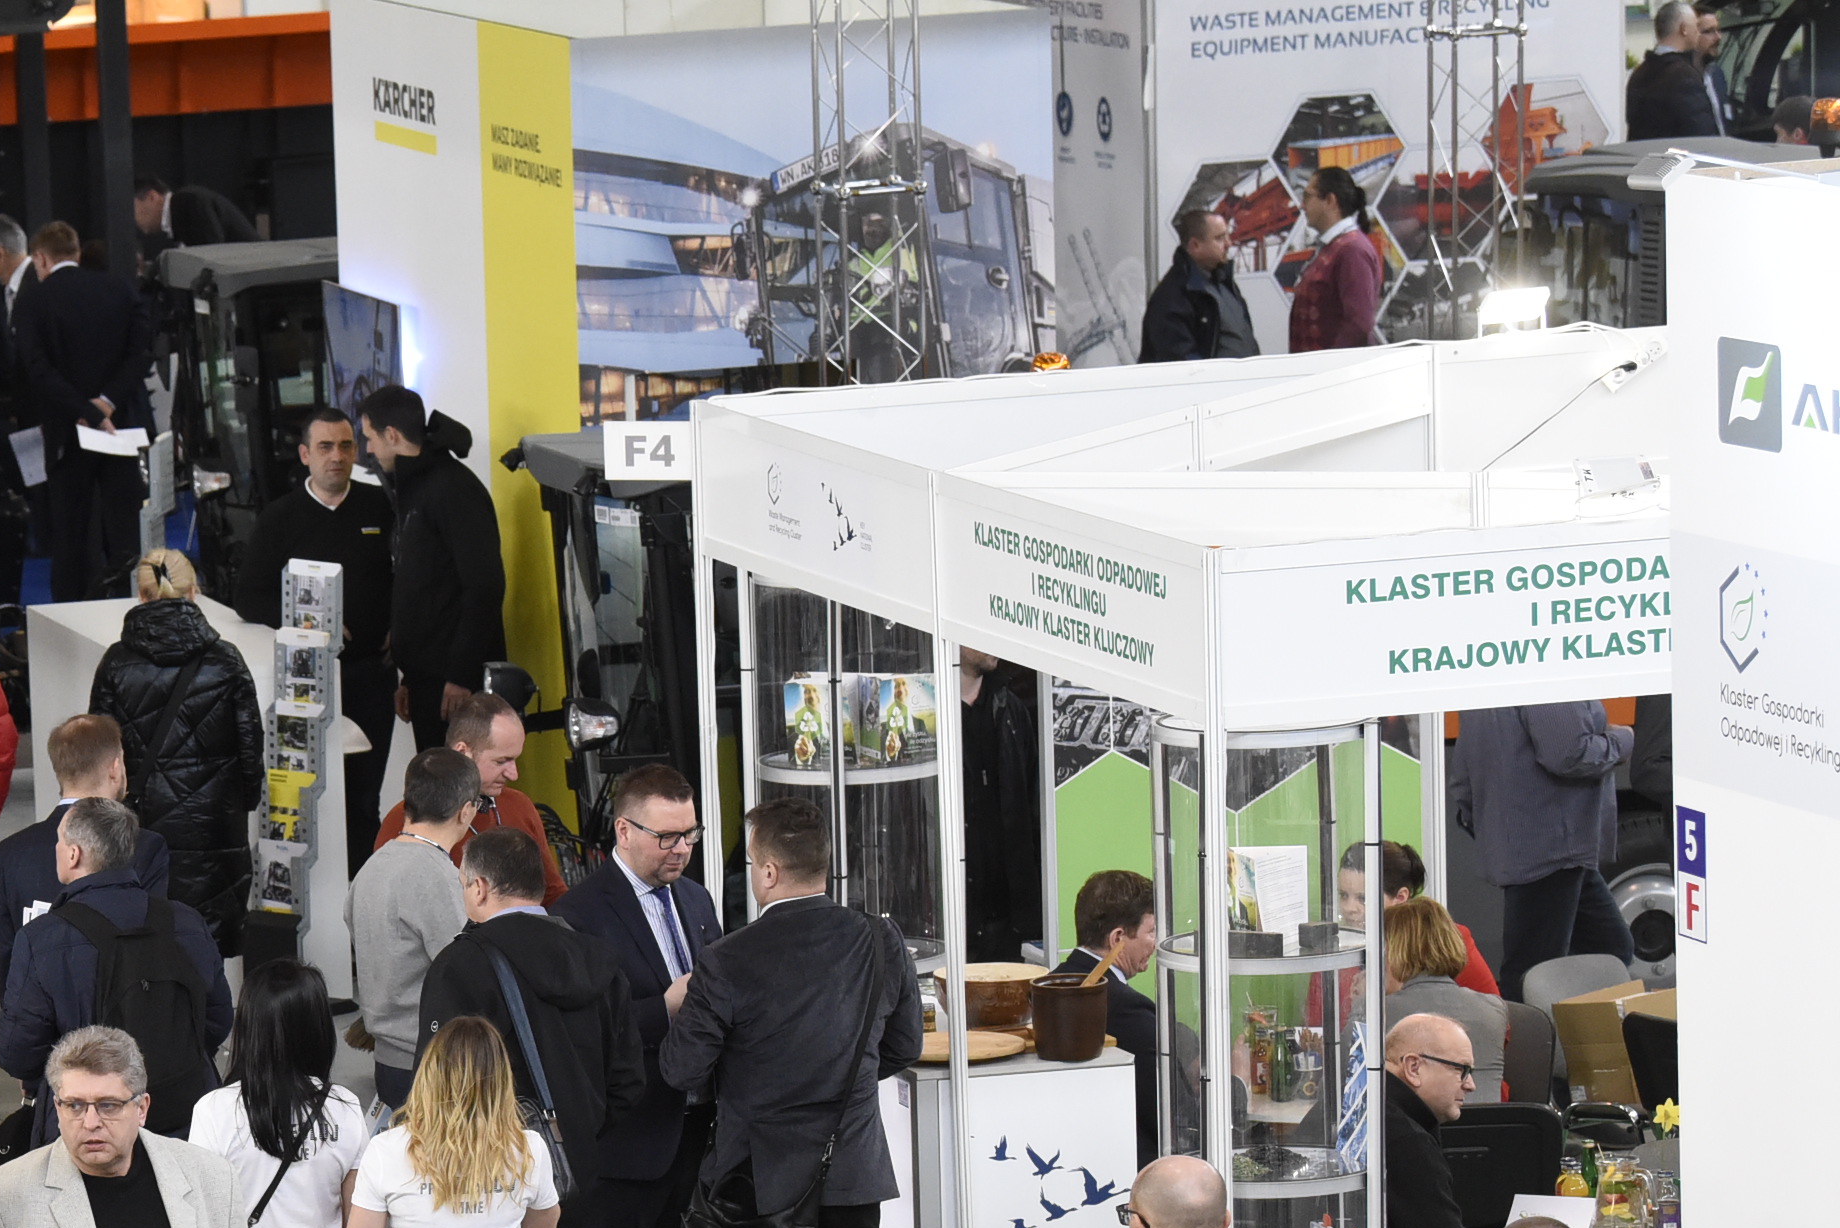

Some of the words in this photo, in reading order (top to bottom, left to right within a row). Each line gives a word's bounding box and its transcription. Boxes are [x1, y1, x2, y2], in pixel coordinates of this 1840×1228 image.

[1189, 13, 1259, 32] WASTE
[1264, 2, 1412, 26] MANAGEMENT
[1190, 34, 1309, 60] EQUIPMENT
[372, 76, 437, 126] KÄRCHER
[490, 123, 509, 147] MASZ
[491, 152, 512, 176] MAMY
[624, 434, 676, 468] F4
[974, 521, 1021, 557] KLASTER
[1023, 535, 1094, 579] GOSPODARKI
[1096, 556, 1167, 600] ODPADOWEJ
[1346, 569, 1495, 605] KLASTER
[1505, 554, 1671, 592] GOSPODA
[1031, 572, 1036, 596] I
[1037, 573, 1107, 617] RECYKLINGU
[1530, 602, 1539, 627] I
[989, 593, 1040, 631] KRAJOWY
[1042, 610, 1091, 648] KLASTER
[1093, 625, 1155, 668] KLUCZOWY
[1388, 637, 1552, 675] KRAJOWY
[1561, 627, 1673, 661] KLAST
[1719, 682, 1759, 711] Klaster
[1761, 692, 1825, 729] Gospodarki
[1720, 716, 1783, 758] Odpadowej
[1790, 733, 1840, 773] Recykling
[1684, 819, 1698, 862] 5
[1685, 881, 1700, 931] F
